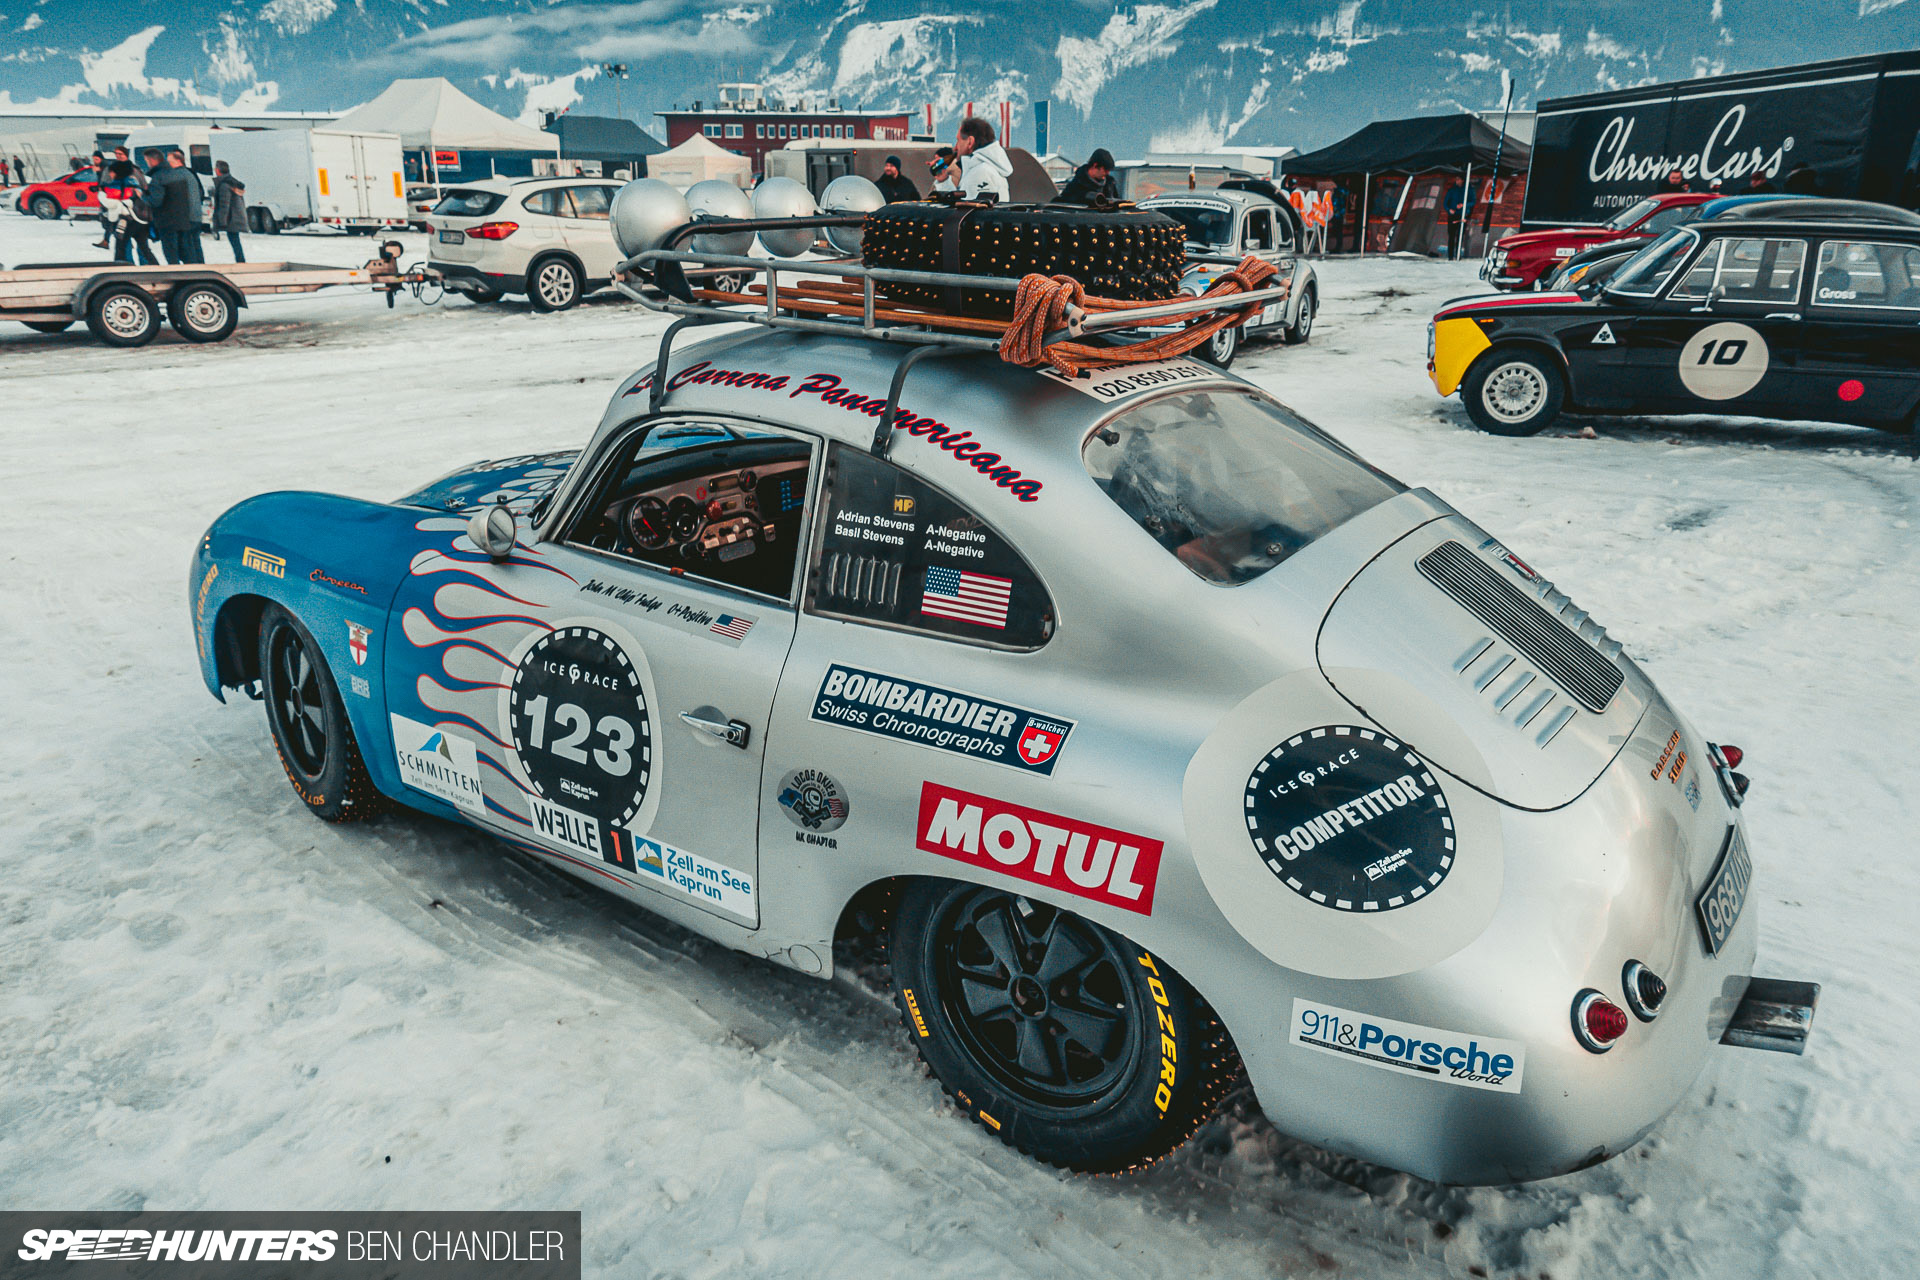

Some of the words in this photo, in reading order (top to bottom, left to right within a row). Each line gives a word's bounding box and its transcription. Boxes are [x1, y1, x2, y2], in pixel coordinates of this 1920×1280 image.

[1818, 287, 1857, 300] Gross
[1697, 339, 1748, 366] 10
[1093, 376, 1136, 398] 020
[666, 360, 791, 392] Carrera
[789, 373, 1043, 502] Panamericana
[834, 524, 860, 539] Basil
[862, 529, 905, 546] Stevens
[924, 539, 985, 559] A-Negative
[836, 509, 871, 525] Adrian
[873, 515, 915, 532] Stevens
[926, 523, 986, 543] A-Negative
[242, 546, 286, 579] PIRELLI
[543, 660, 565, 676] ICE
[584, 671, 618, 691] RACE
[823, 669, 1017, 738] BOMBARDIER
[524, 694, 635, 777] 123
[817, 699, 868, 725] Swiss
[872, 711, 1006, 757] Chronographs
[399, 750, 481, 796] SCHMITTEN
[1269, 779, 1299, 799] ICE
[1316, 748, 1360, 778] RACE
[1274, 774, 1425, 861] COMPETITOR
[925, 797, 1146, 901] MOTUL
[666, 847, 694, 873] Zell
[696, 862, 720, 884] am
[721, 869, 751, 895] See
[667, 866, 723, 901] Kaprun
[1450, 1065, 1509, 1086] World
